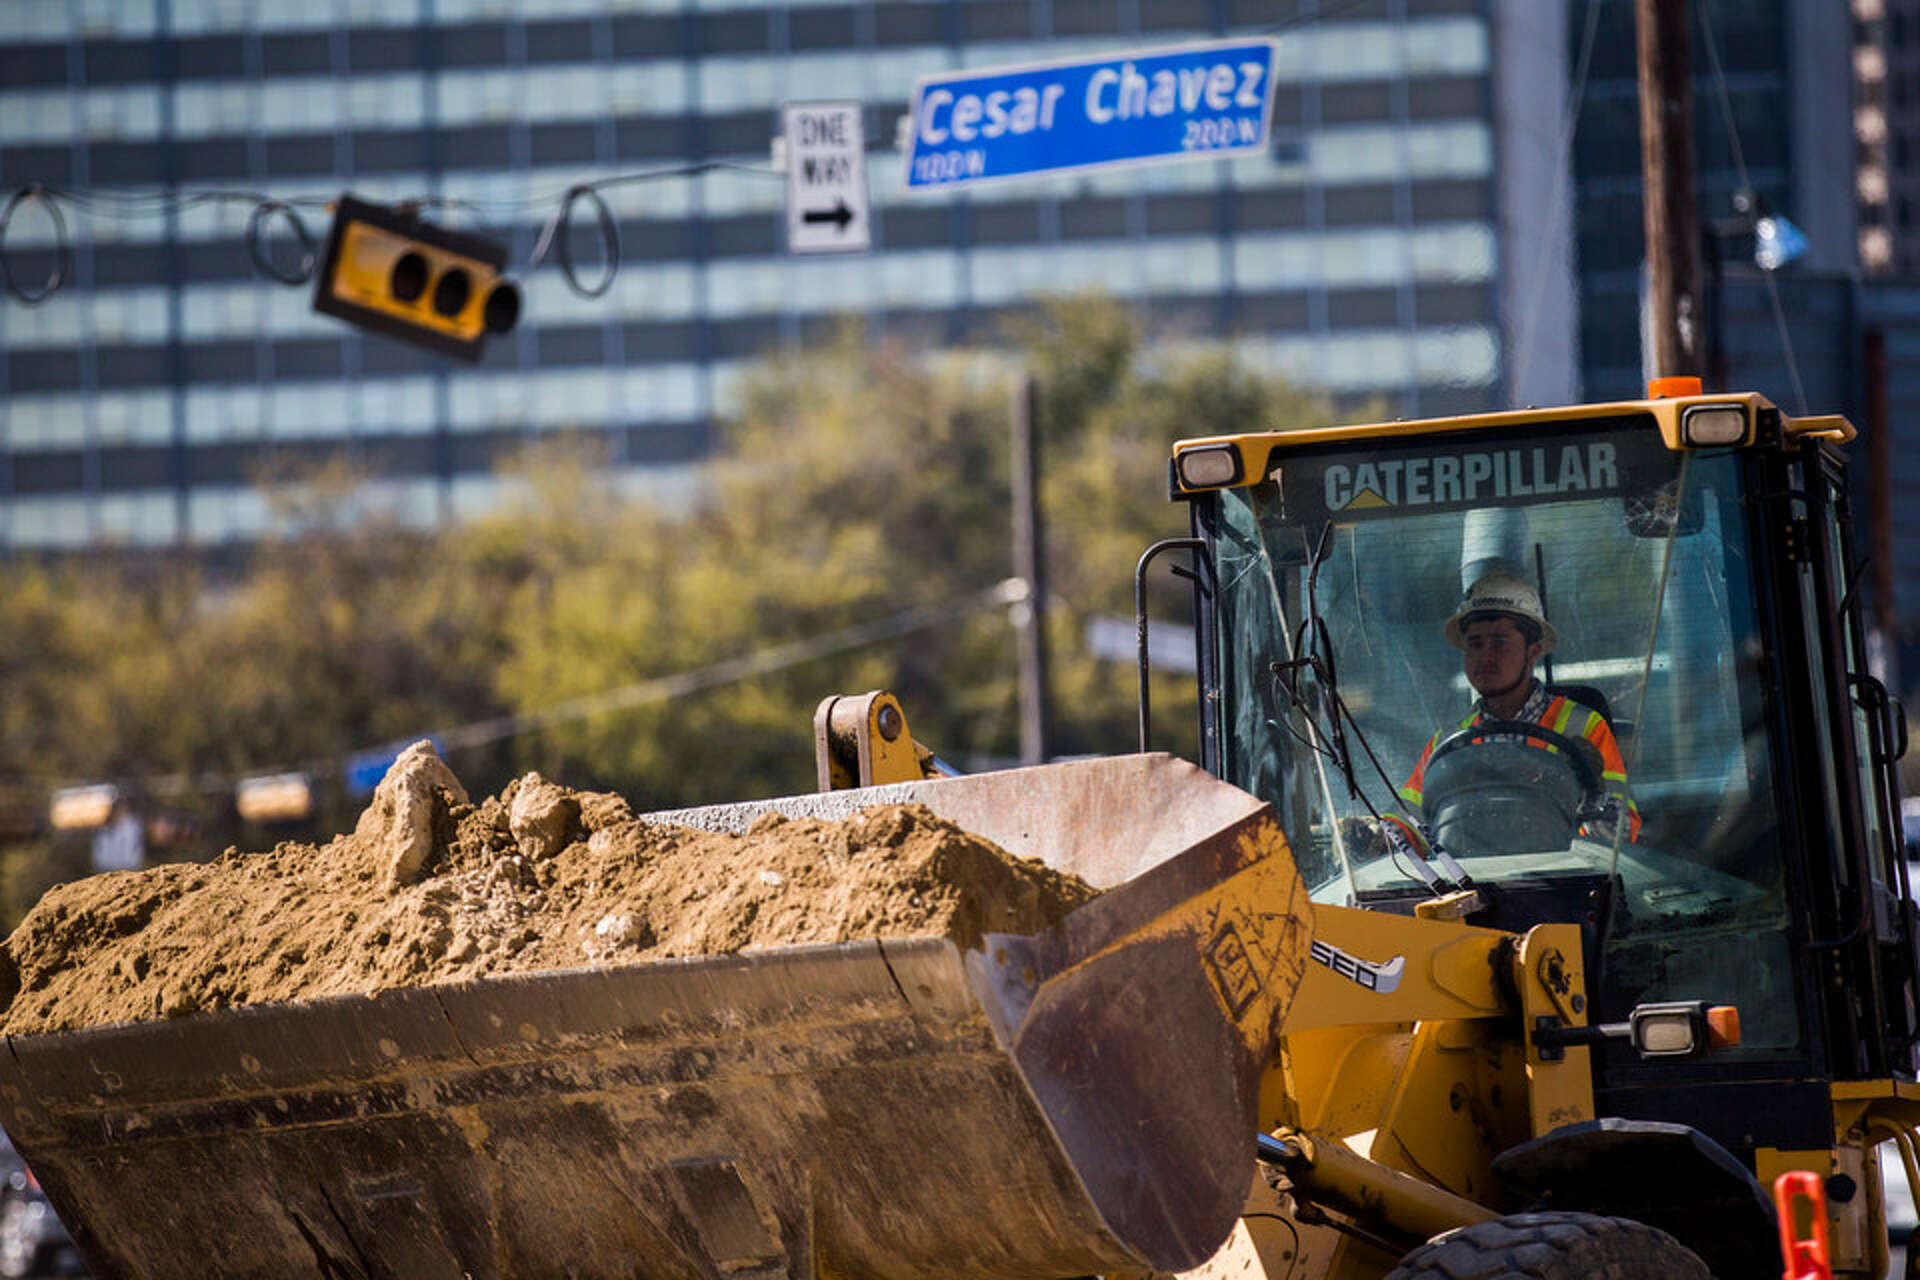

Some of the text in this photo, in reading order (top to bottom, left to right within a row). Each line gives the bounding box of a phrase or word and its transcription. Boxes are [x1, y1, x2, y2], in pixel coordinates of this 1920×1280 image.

[799, 111, 846, 147] ONE
[920, 60, 1265, 146] Cesar Chavez
[803, 154, 852, 187] WAY
[1324, 442, 1619, 512] CATERPILLAR
